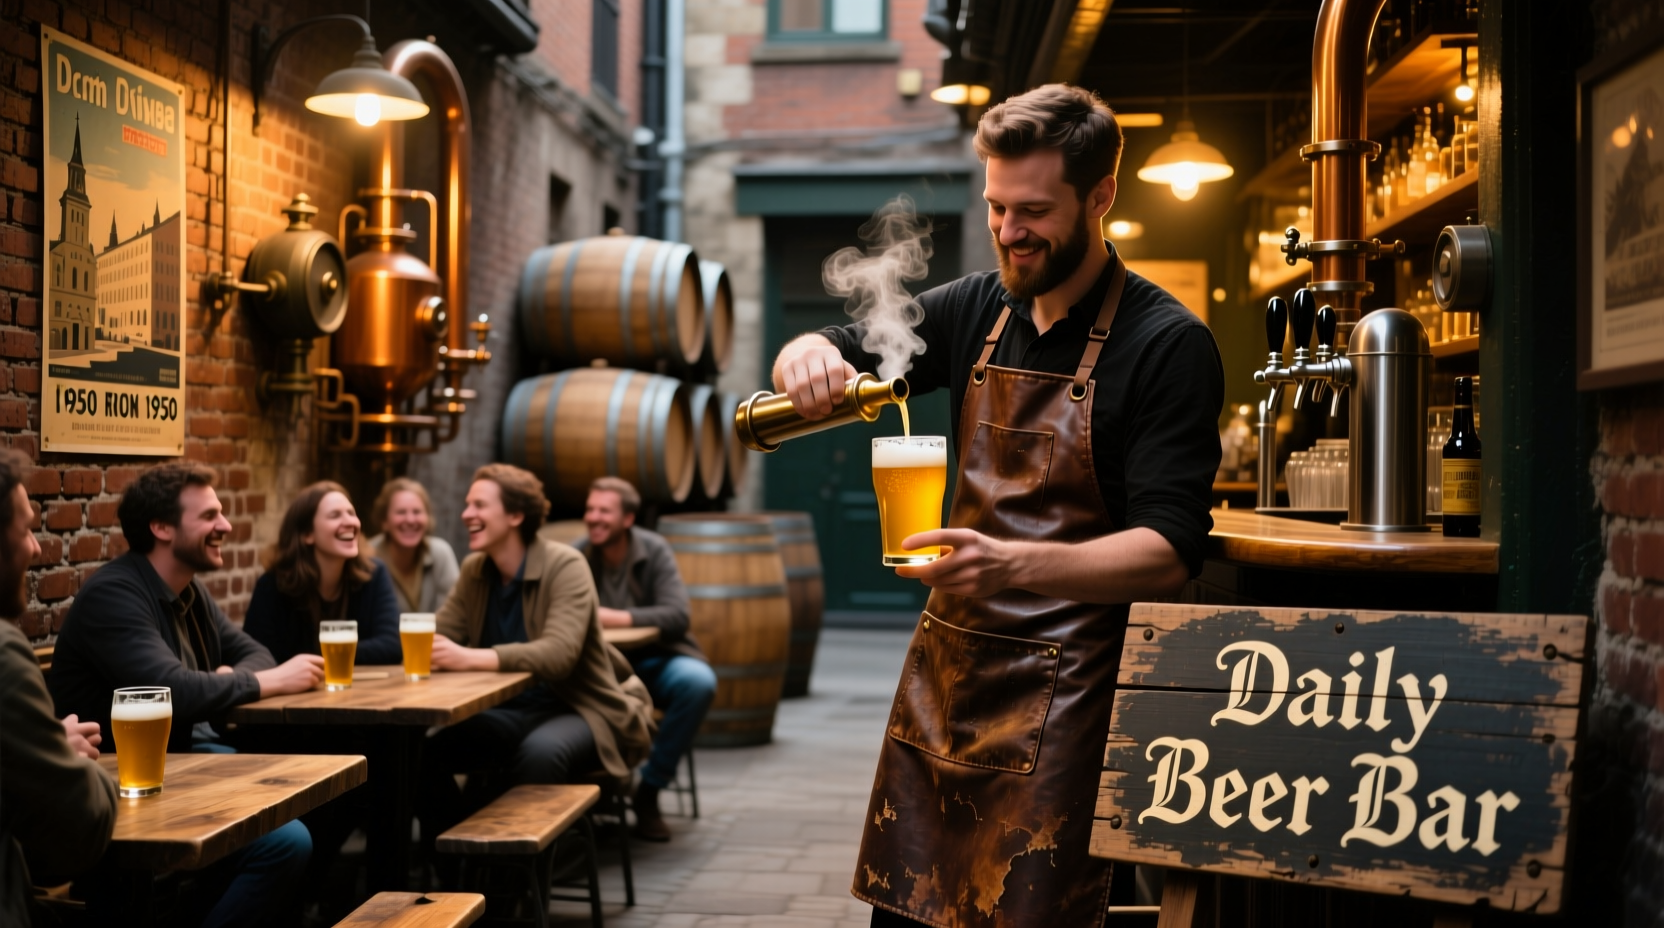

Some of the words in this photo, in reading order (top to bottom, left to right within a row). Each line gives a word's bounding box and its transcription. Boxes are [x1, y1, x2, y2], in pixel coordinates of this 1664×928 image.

[146, 395, 178, 421] 1950
[1210, 640, 1448, 753] Daily
[1137, 736, 1330, 836] Beer
[1340, 752, 1521, 857] Bar
